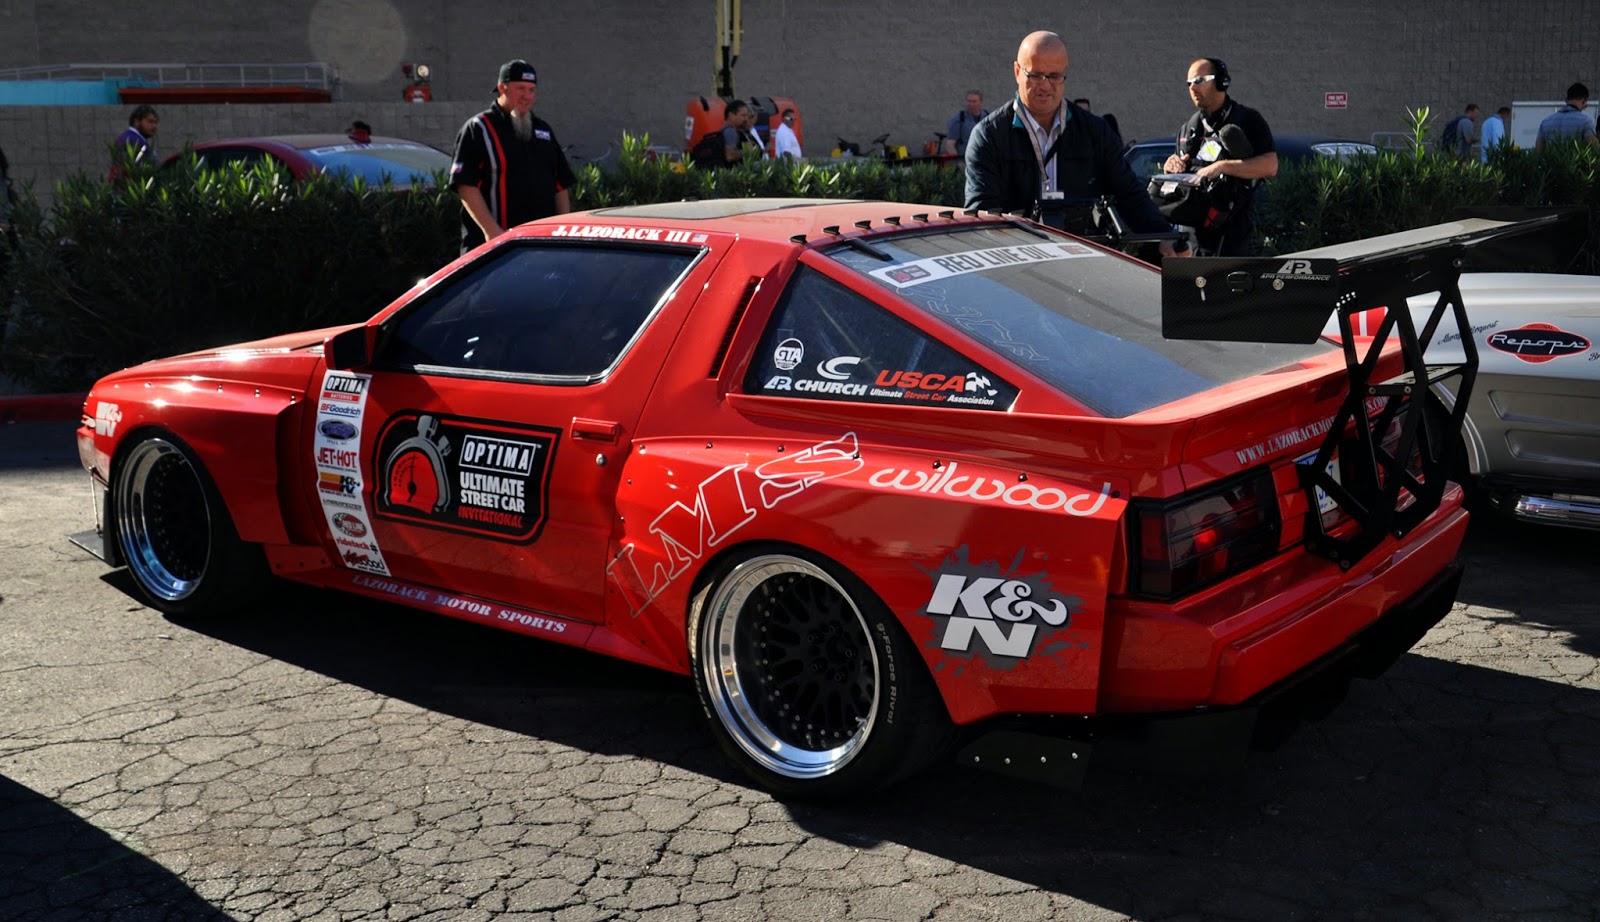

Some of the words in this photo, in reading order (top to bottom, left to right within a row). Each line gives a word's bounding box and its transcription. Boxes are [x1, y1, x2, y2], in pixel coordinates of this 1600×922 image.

[665, 231, 693, 243] III
[932, 254, 979, 273] RED
[978, 247, 1022, 266] LINE
[1020, 246, 1057, 260] OIL
[775, 346, 802, 363] GTA
[1491, 334, 1587, 355] Repops
[327, 377, 363, 392] OPTIMA
[794, 379, 868, 396] CHURCH
[874, 369, 966, 393] USCA
[869, 388, 903, 398] Ultimate
[903, 391, 930, 400] Street
[931, 392, 947, 401] Car
[947, 394, 995, 406] Association
[321, 403, 361, 415] BFGoodrich
[317, 447, 357, 468] JET-HOT
[463, 441, 530, 470] OPTIMA
[460, 471, 525, 498] ULTIMATE
[868, 461, 1112, 516] wilwood
[460, 490, 500, 509] STREET
[501, 496, 526, 513] CAR
[458, 506, 523, 529] INVITATIONAL
[351, 575, 429, 601] LAZORACK
[434, 594, 492, 616] MOTOR
[497, 609, 568, 633] SPORTS
